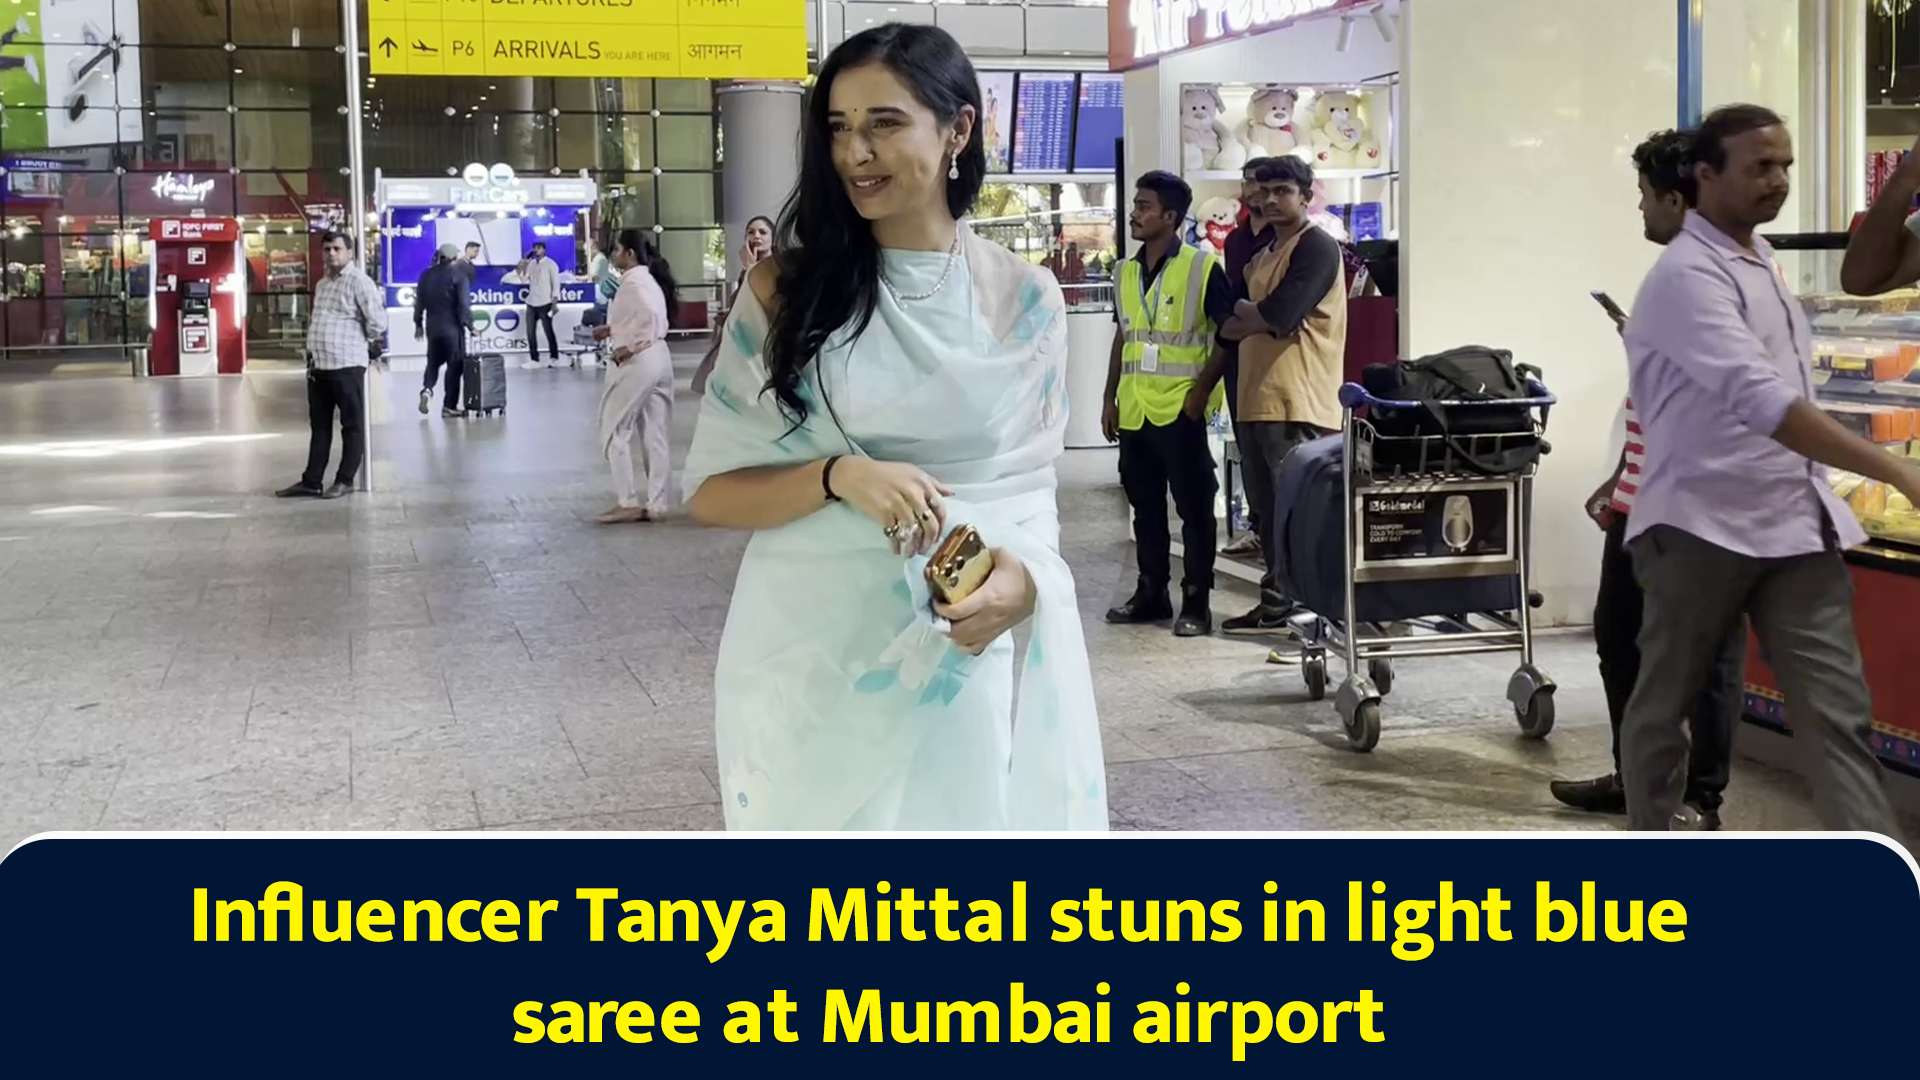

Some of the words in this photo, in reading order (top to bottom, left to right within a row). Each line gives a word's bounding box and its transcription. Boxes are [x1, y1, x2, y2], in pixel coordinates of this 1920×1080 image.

[452, 40, 475, 57] P6
[493, 40, 601, 59] ARRIVALS
[604, 51, 623, 60] YOU
[625, 51, 644, 61] ARE
[647, 51, 671, 61] HERE
[687, 43, 743, 60] आगमन
[470, 288, 513, 305] oking
